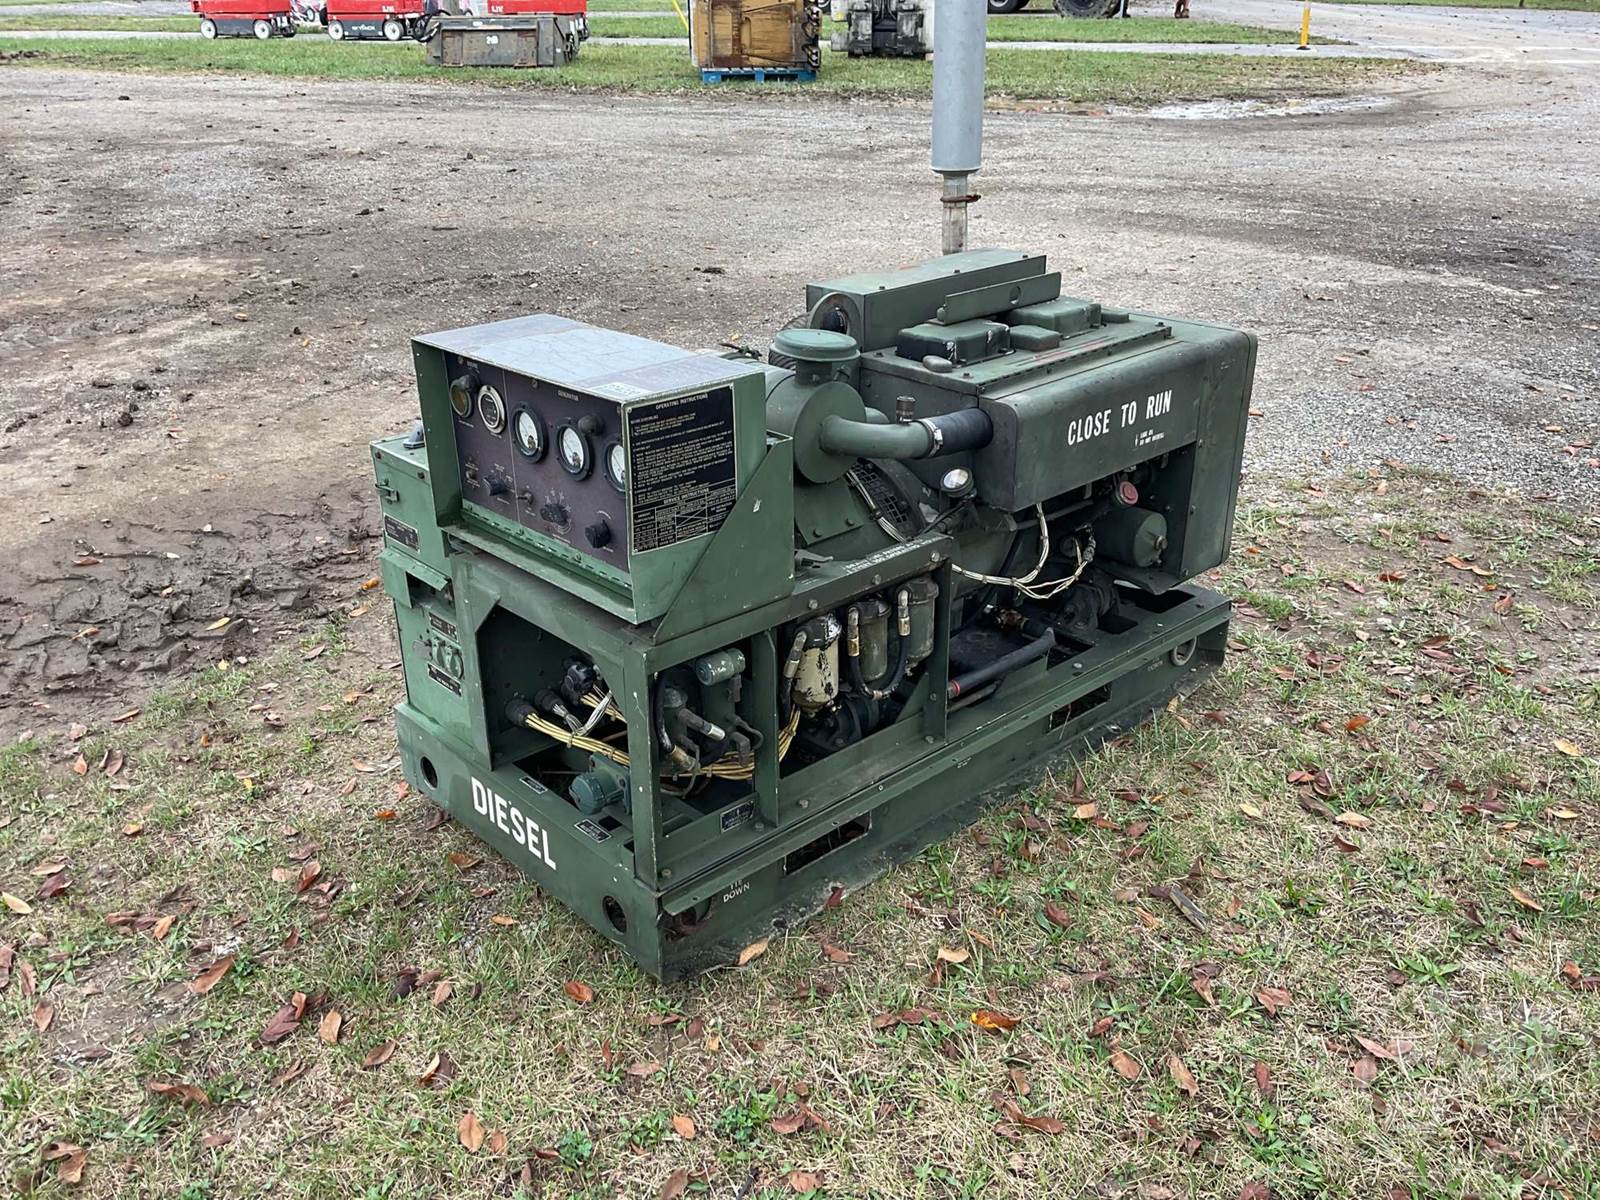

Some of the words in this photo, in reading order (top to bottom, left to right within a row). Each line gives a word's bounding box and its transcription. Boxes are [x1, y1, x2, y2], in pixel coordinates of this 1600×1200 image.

[655, 399, 679, 410] OPERATING
[679, 393, 708, 405] INSTRUCTIONS
[1068, 409, 1112, 446] CLOSE
[1121, 400, 1137, 428] TO
[1146, 390, 1173, 420] RUN
[470, 776, 557, 871] DIESEL
[723, 881, 751, 903] DOWN
